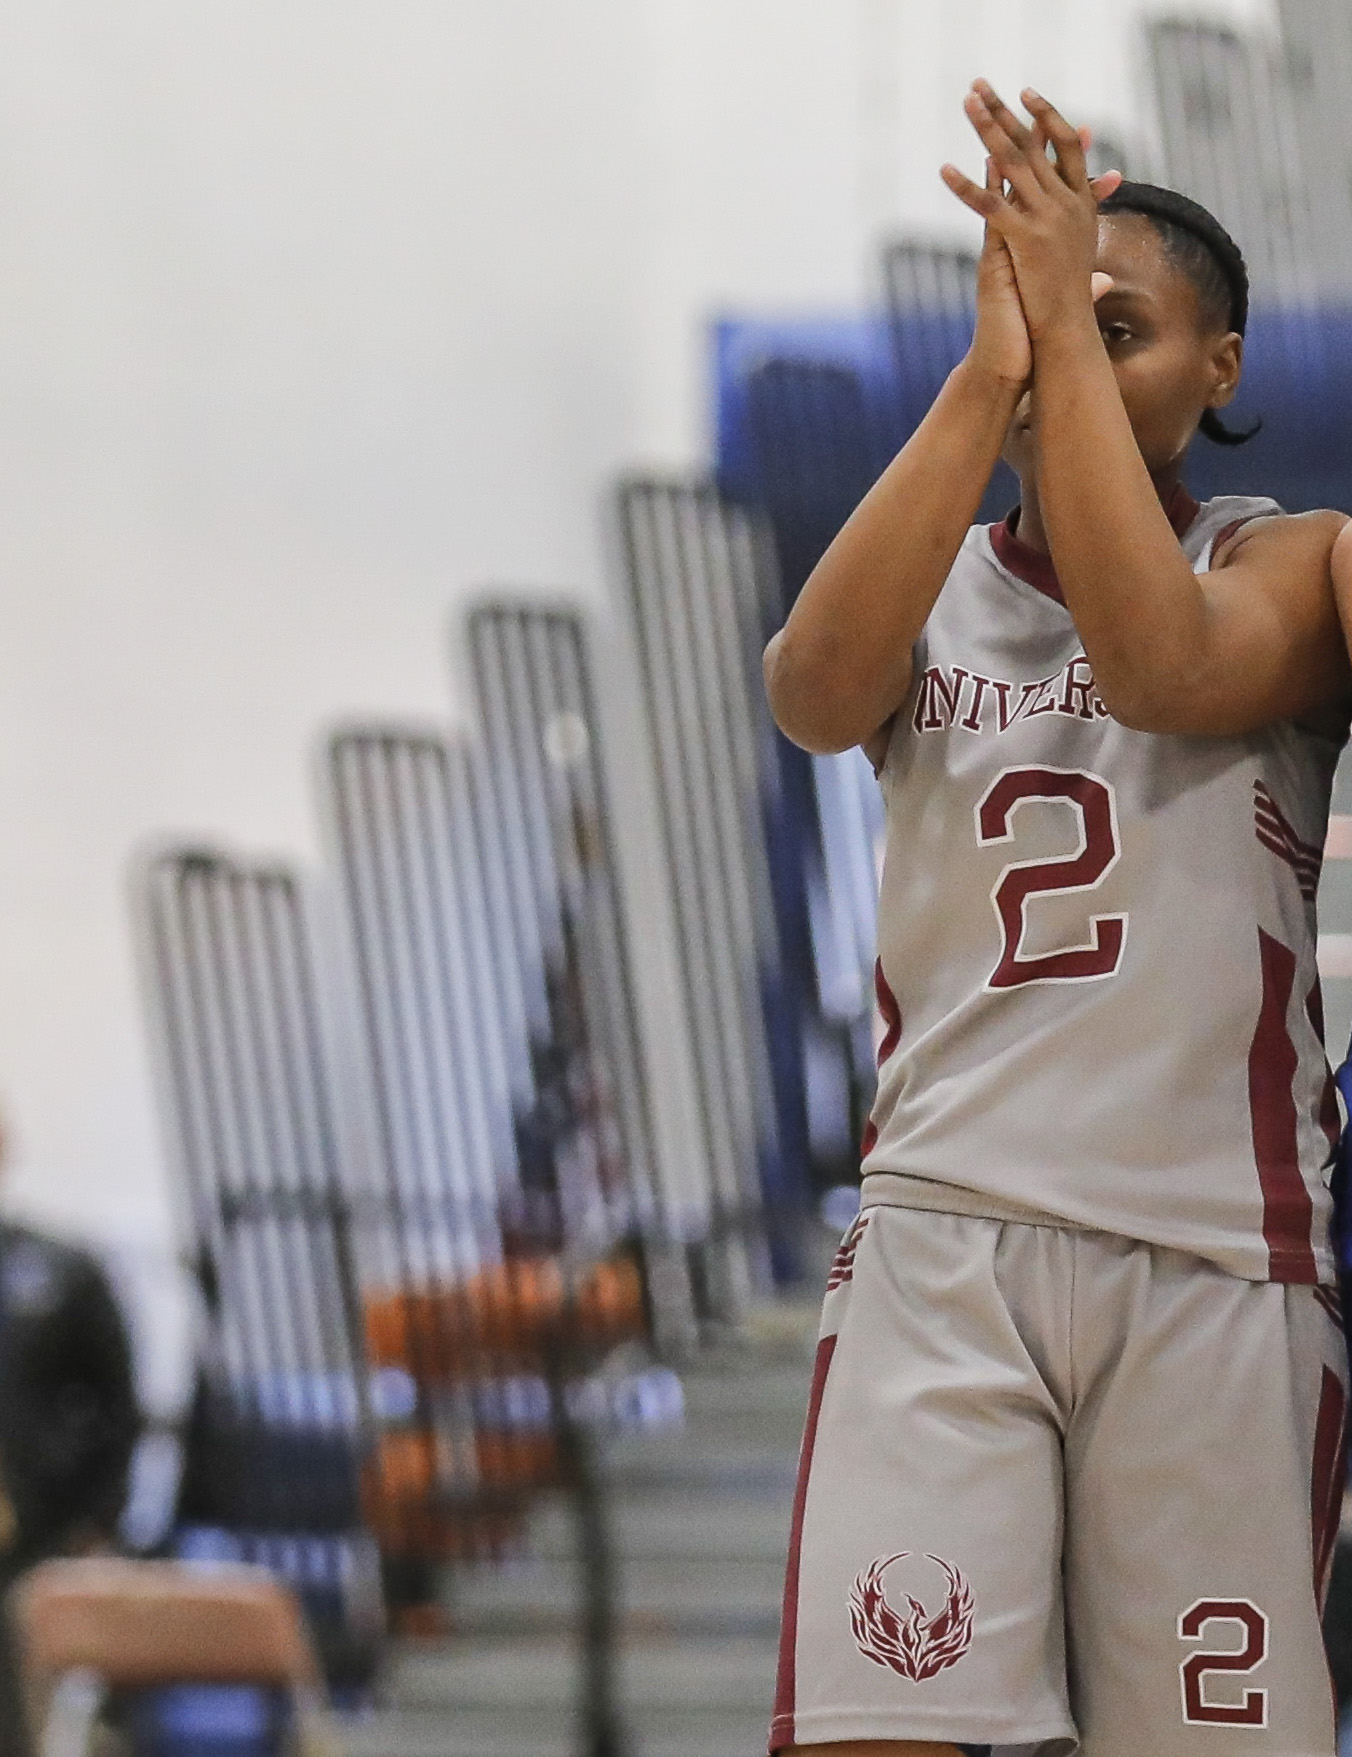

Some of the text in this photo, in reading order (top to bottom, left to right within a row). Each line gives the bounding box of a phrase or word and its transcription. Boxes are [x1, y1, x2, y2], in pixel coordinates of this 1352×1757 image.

[912, 654, 1111, 736] NIVER
[973, 763, 1129, 994] 2
[1177, 1597, 1269, 1729] 2
